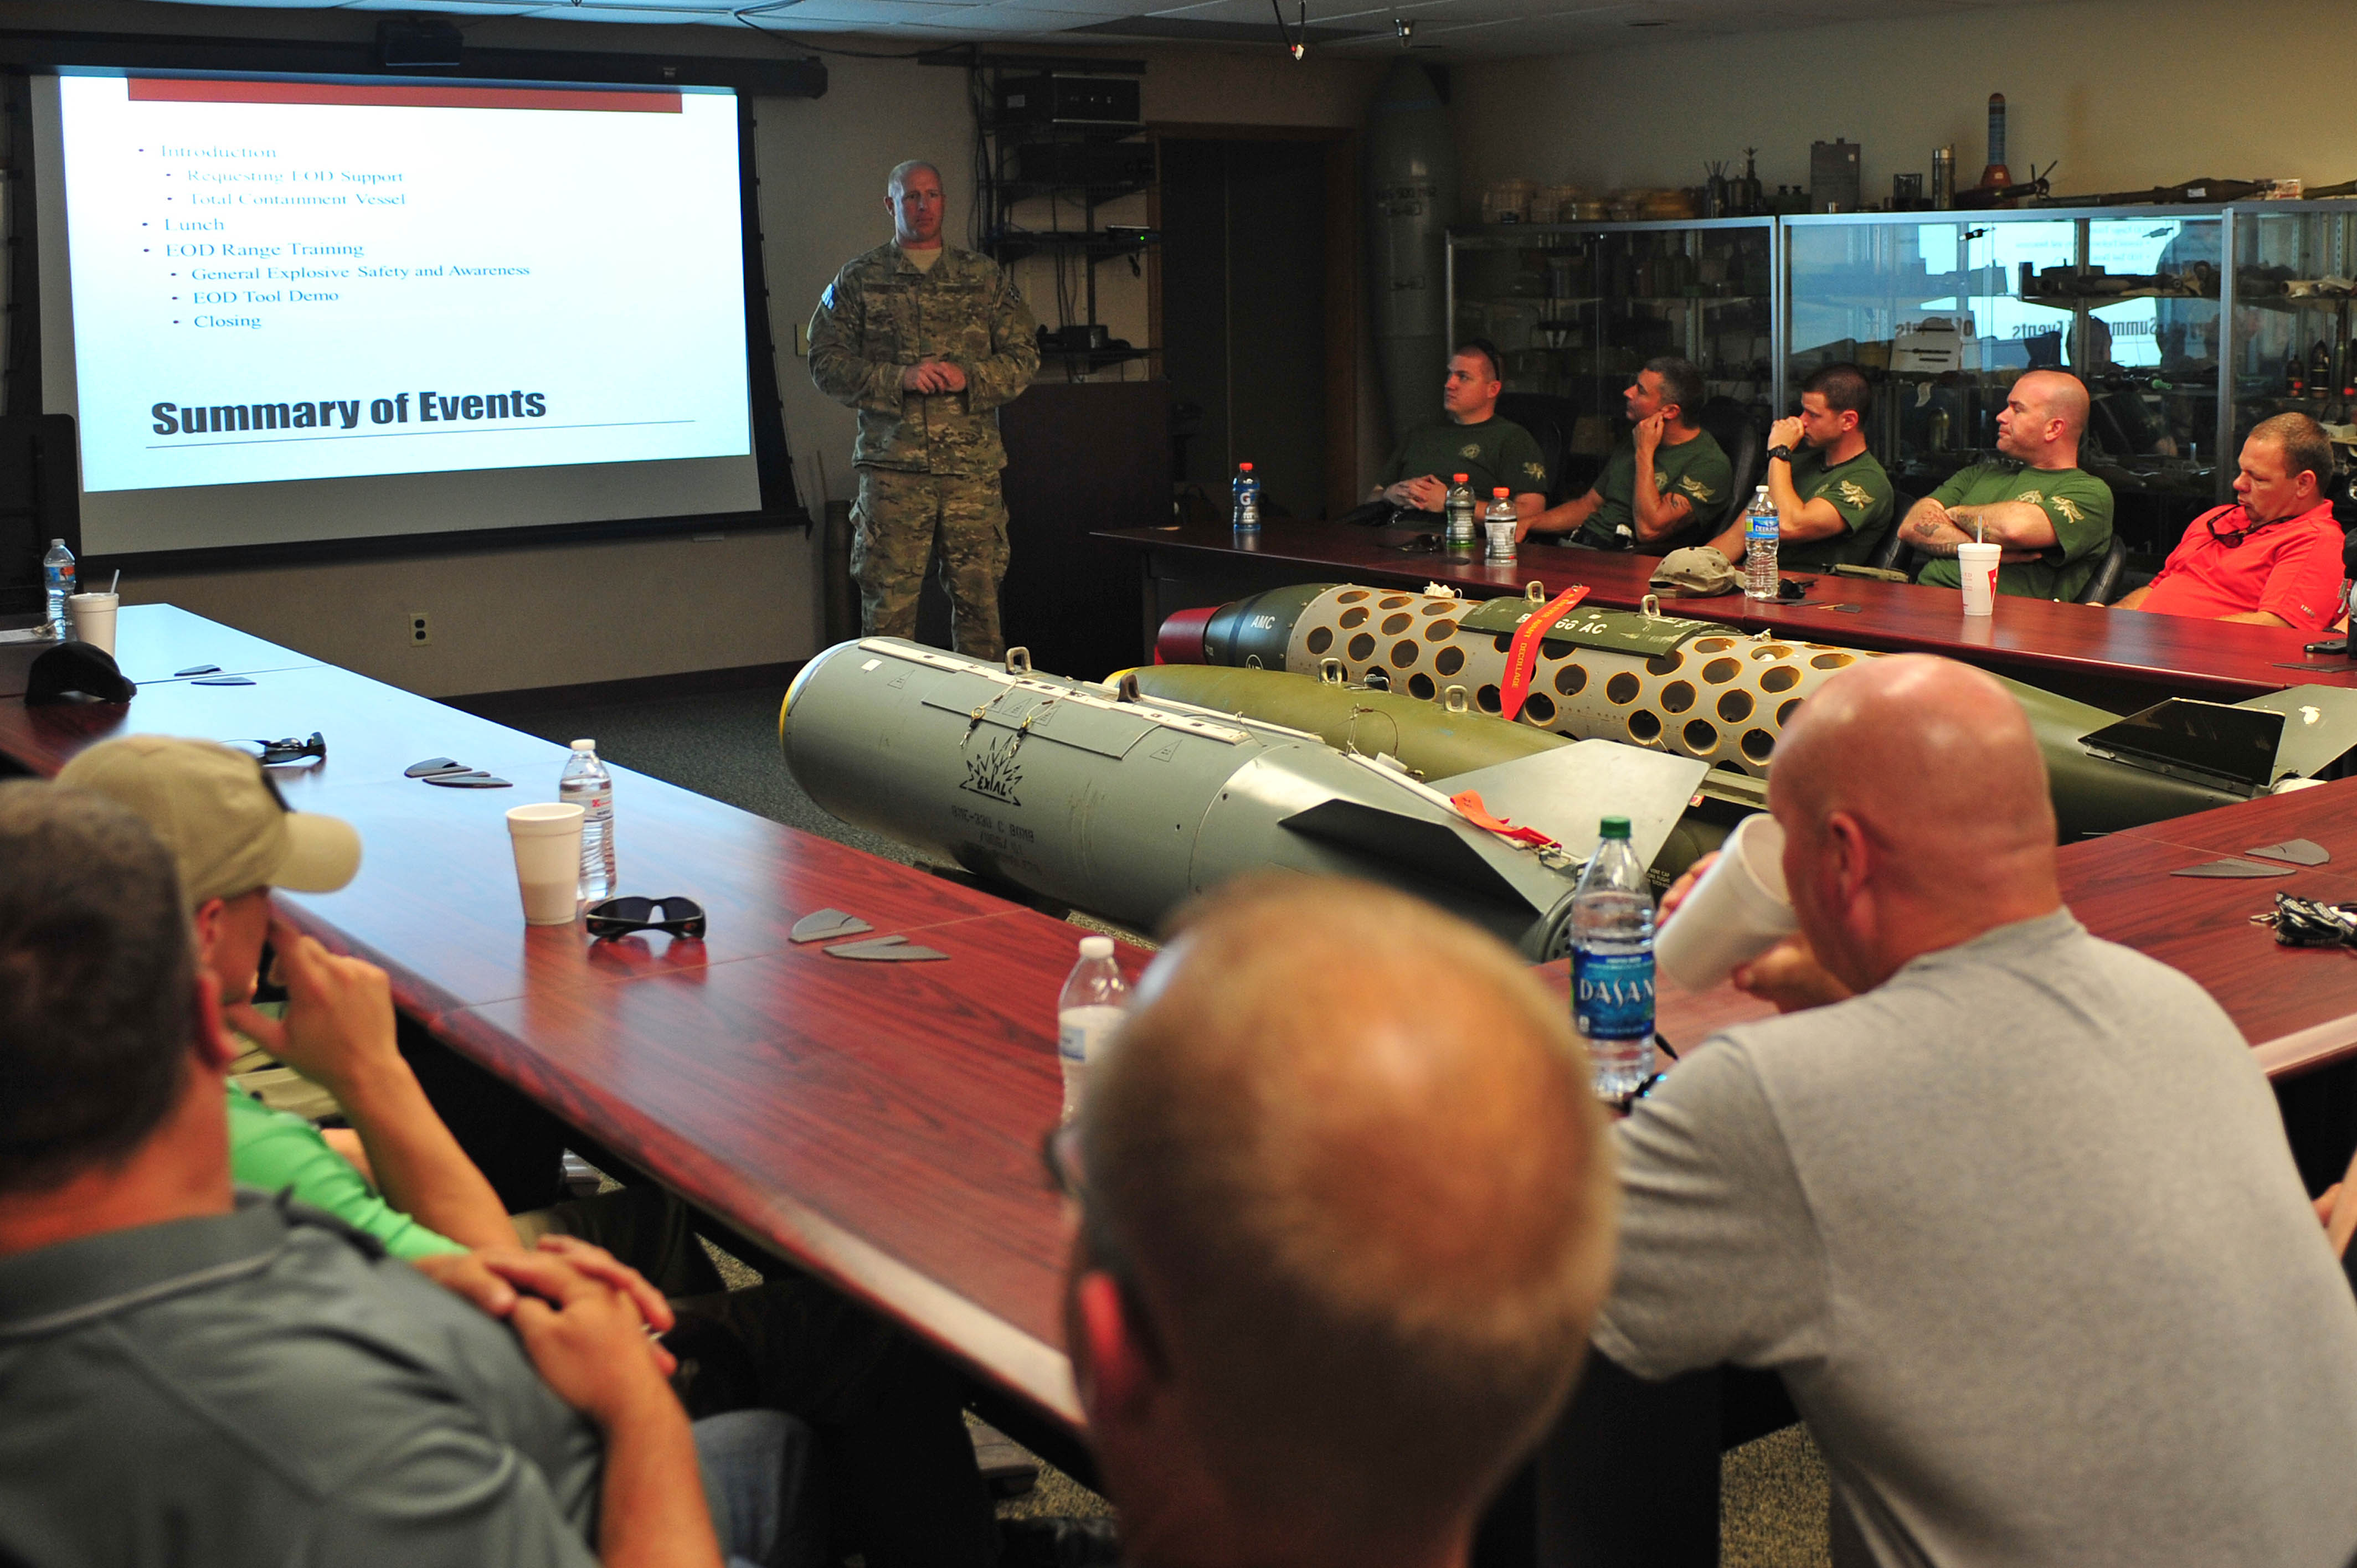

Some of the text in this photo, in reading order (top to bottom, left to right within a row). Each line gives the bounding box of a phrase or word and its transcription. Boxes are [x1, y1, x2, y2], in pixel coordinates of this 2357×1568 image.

[162, 144, 277, 159] Introduction
[187, 169, 403, 185] Requesting EOD Support
[192, 193, 408, 205] Total Containment Vessel
[165, 217, 225, 231] Lunch
[166, 243, 366, 260] EOD Range Training
[191, 265, 532, 282] General Explosive Safety and Awareness
[193, 290, 342, 305] EOD Tool Demo
[193, 314, 262, 330] Closing
[151, 390, 547, 435] Summary of Events
[1250, 615, 1276, 630] AMC
[1578, 622, 1608, 635] AC
[1511, 642, 1528, 688] DECOLLAGE
[997, 821, 1005, 833] C
